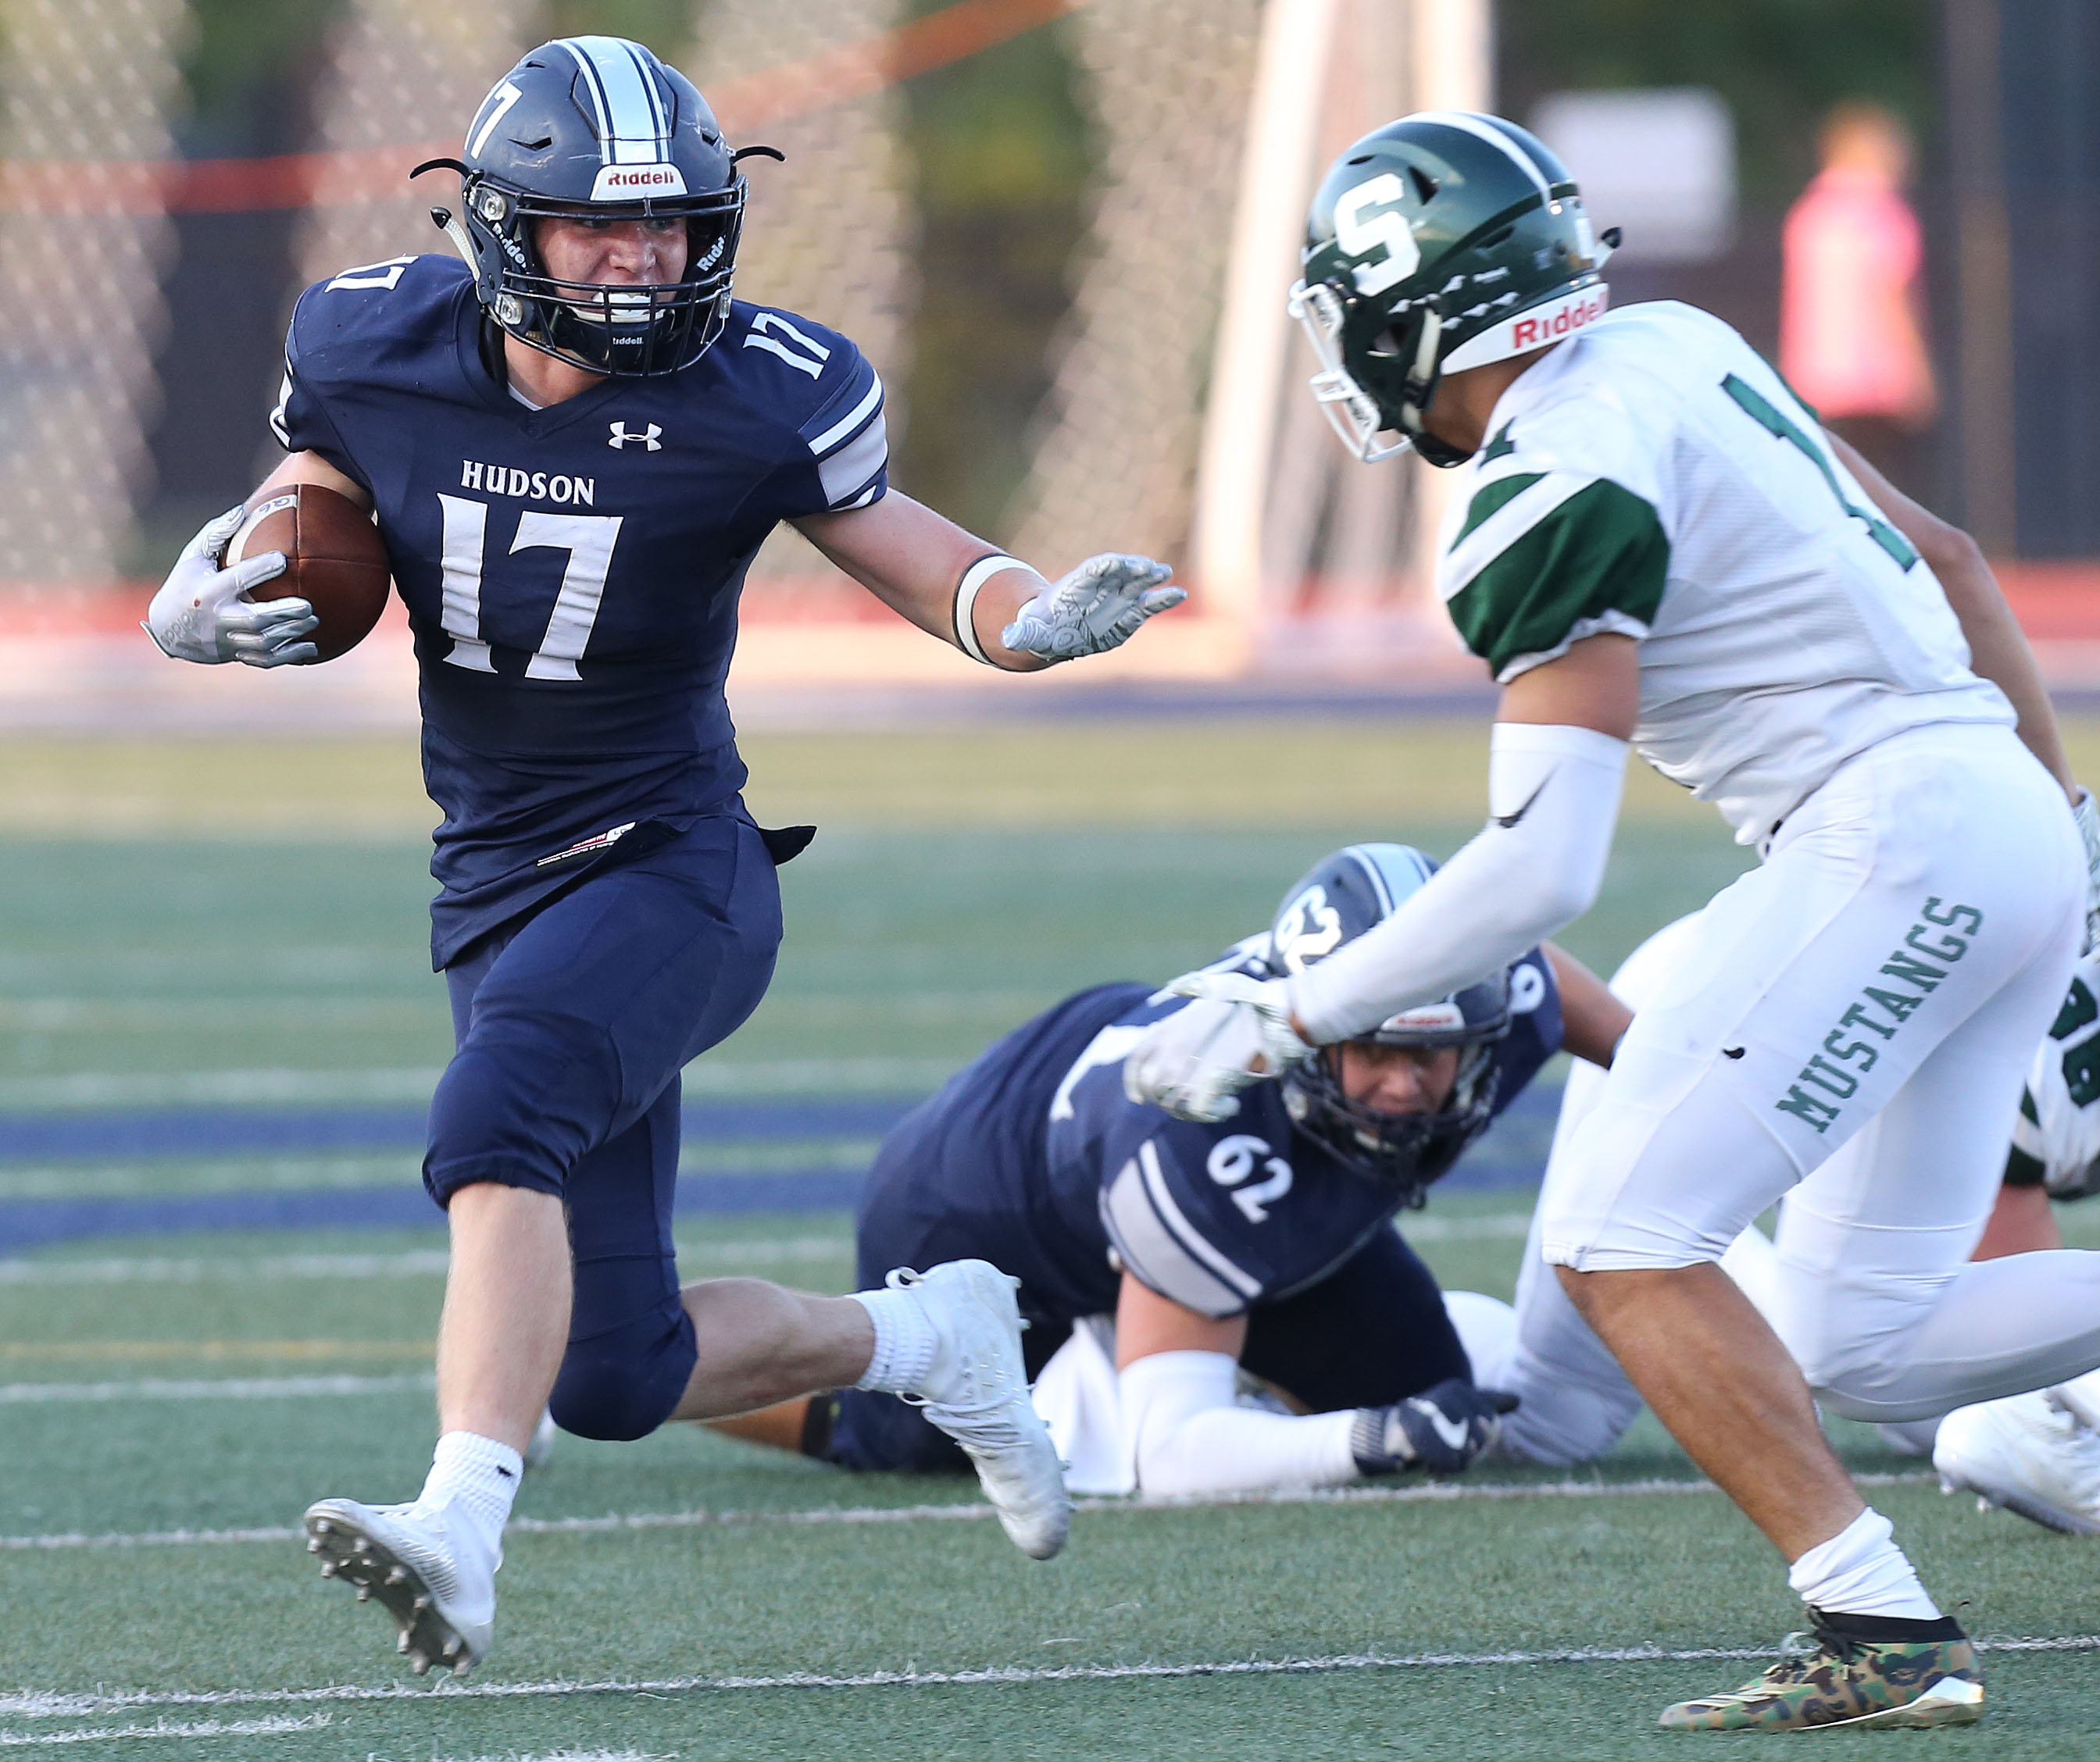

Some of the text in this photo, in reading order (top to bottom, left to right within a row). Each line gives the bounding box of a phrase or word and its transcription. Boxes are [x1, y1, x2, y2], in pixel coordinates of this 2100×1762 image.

[608, 171, 674, 186] Riddell
[1333, 172, 1421, 297] S
[742, 312, 830, 381] 17
[460, 459, 595, 507] HUDSON
[437, 492, 624, 681] 17
[1775, 896, 1984, 1133] MUSTANGS
[1207, 1133, 1294, 1224] 62
